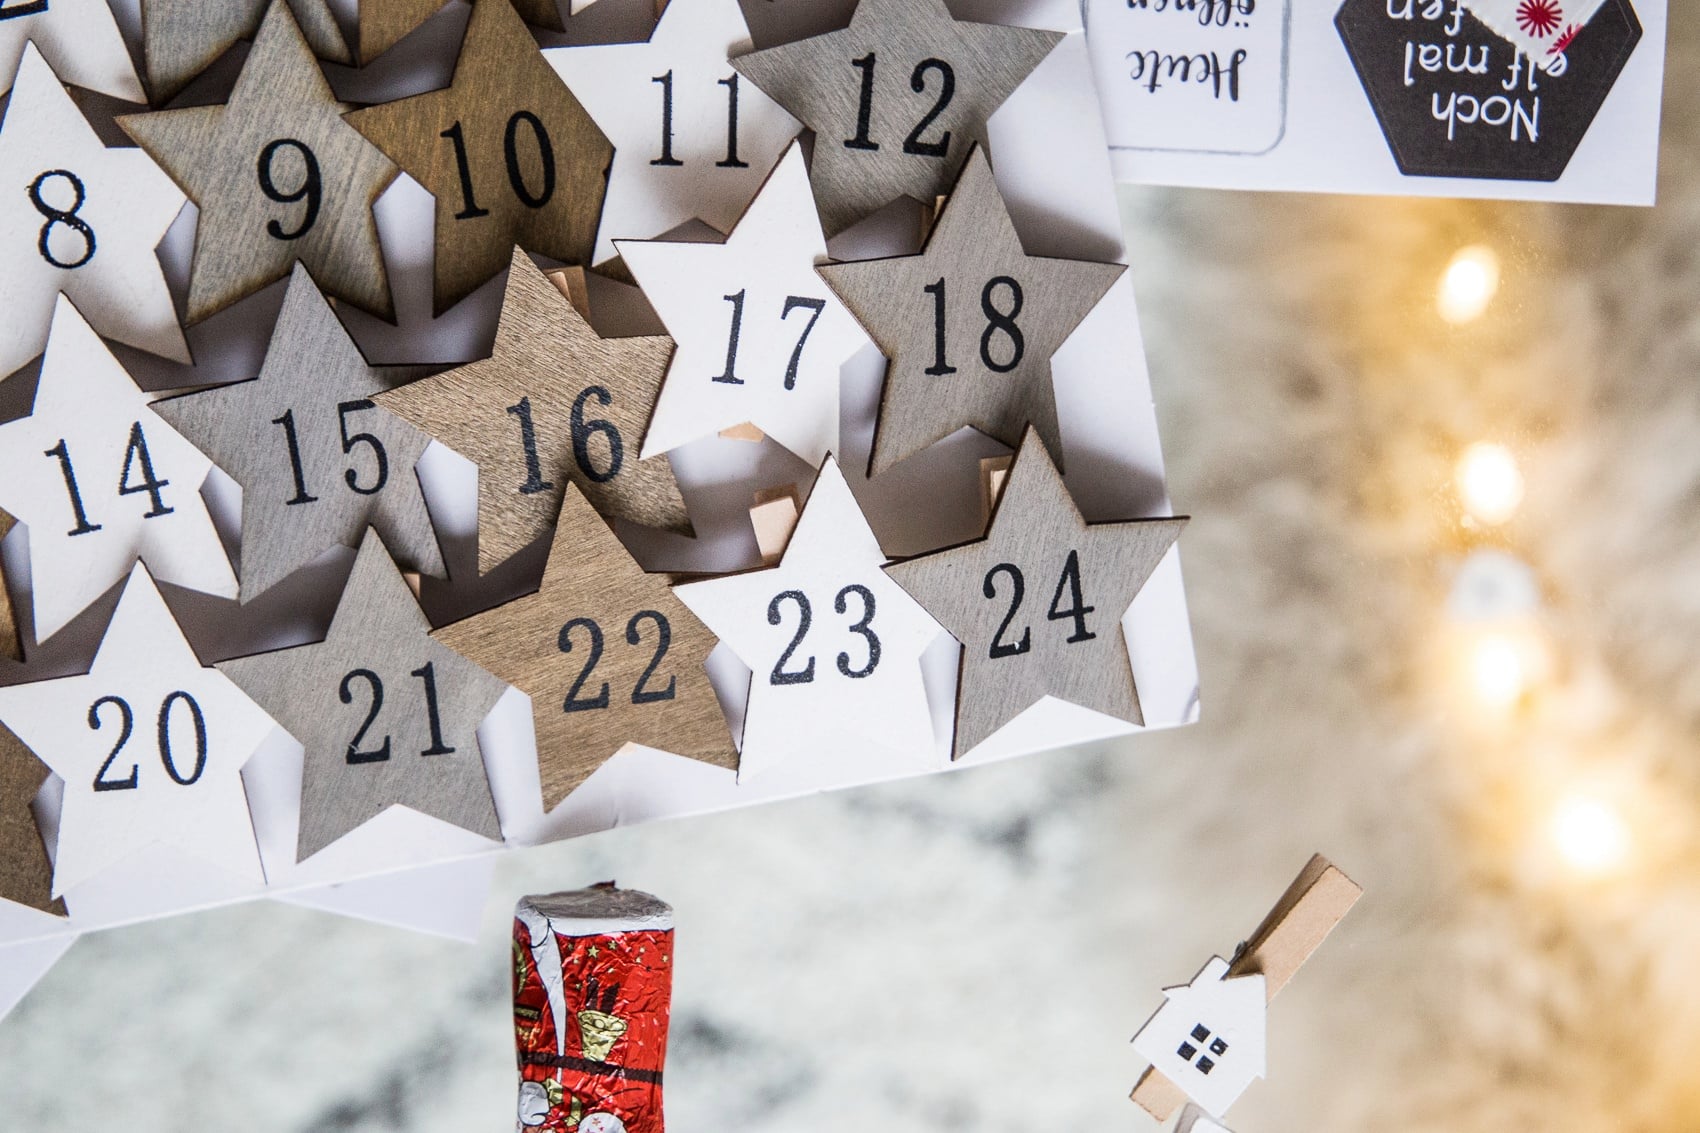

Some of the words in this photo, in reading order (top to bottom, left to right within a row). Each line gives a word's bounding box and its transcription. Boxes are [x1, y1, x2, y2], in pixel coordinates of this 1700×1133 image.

[843, 52, 956, 157] 12
[1125, 48, 1247, 102] Heute
[1404, 40, 1490, 87] mal
[1501, 48, 1569, 92] elf
[440, 110, 556, 220] 10
[649, 69, 750, 169] 11
[1431, 91, 1539, 143] Noch
[26, 169, 97, 270] 8
[257, 138, 322, 242] 9
[712, 288, 826, 391] 17
[923, 275, 1025, 377] 18
[44, 421, 174, 537] 14
[271, 398, 389, 506] 15
[506, 385, 624, 495] 16
[767, 584, 881, 685] 23
[982, 549, 1096, 660] 24
[338, 661, 456, 765] 21
[557, 610, 676, 713] 22
[88, 691, 207, 792] 20
